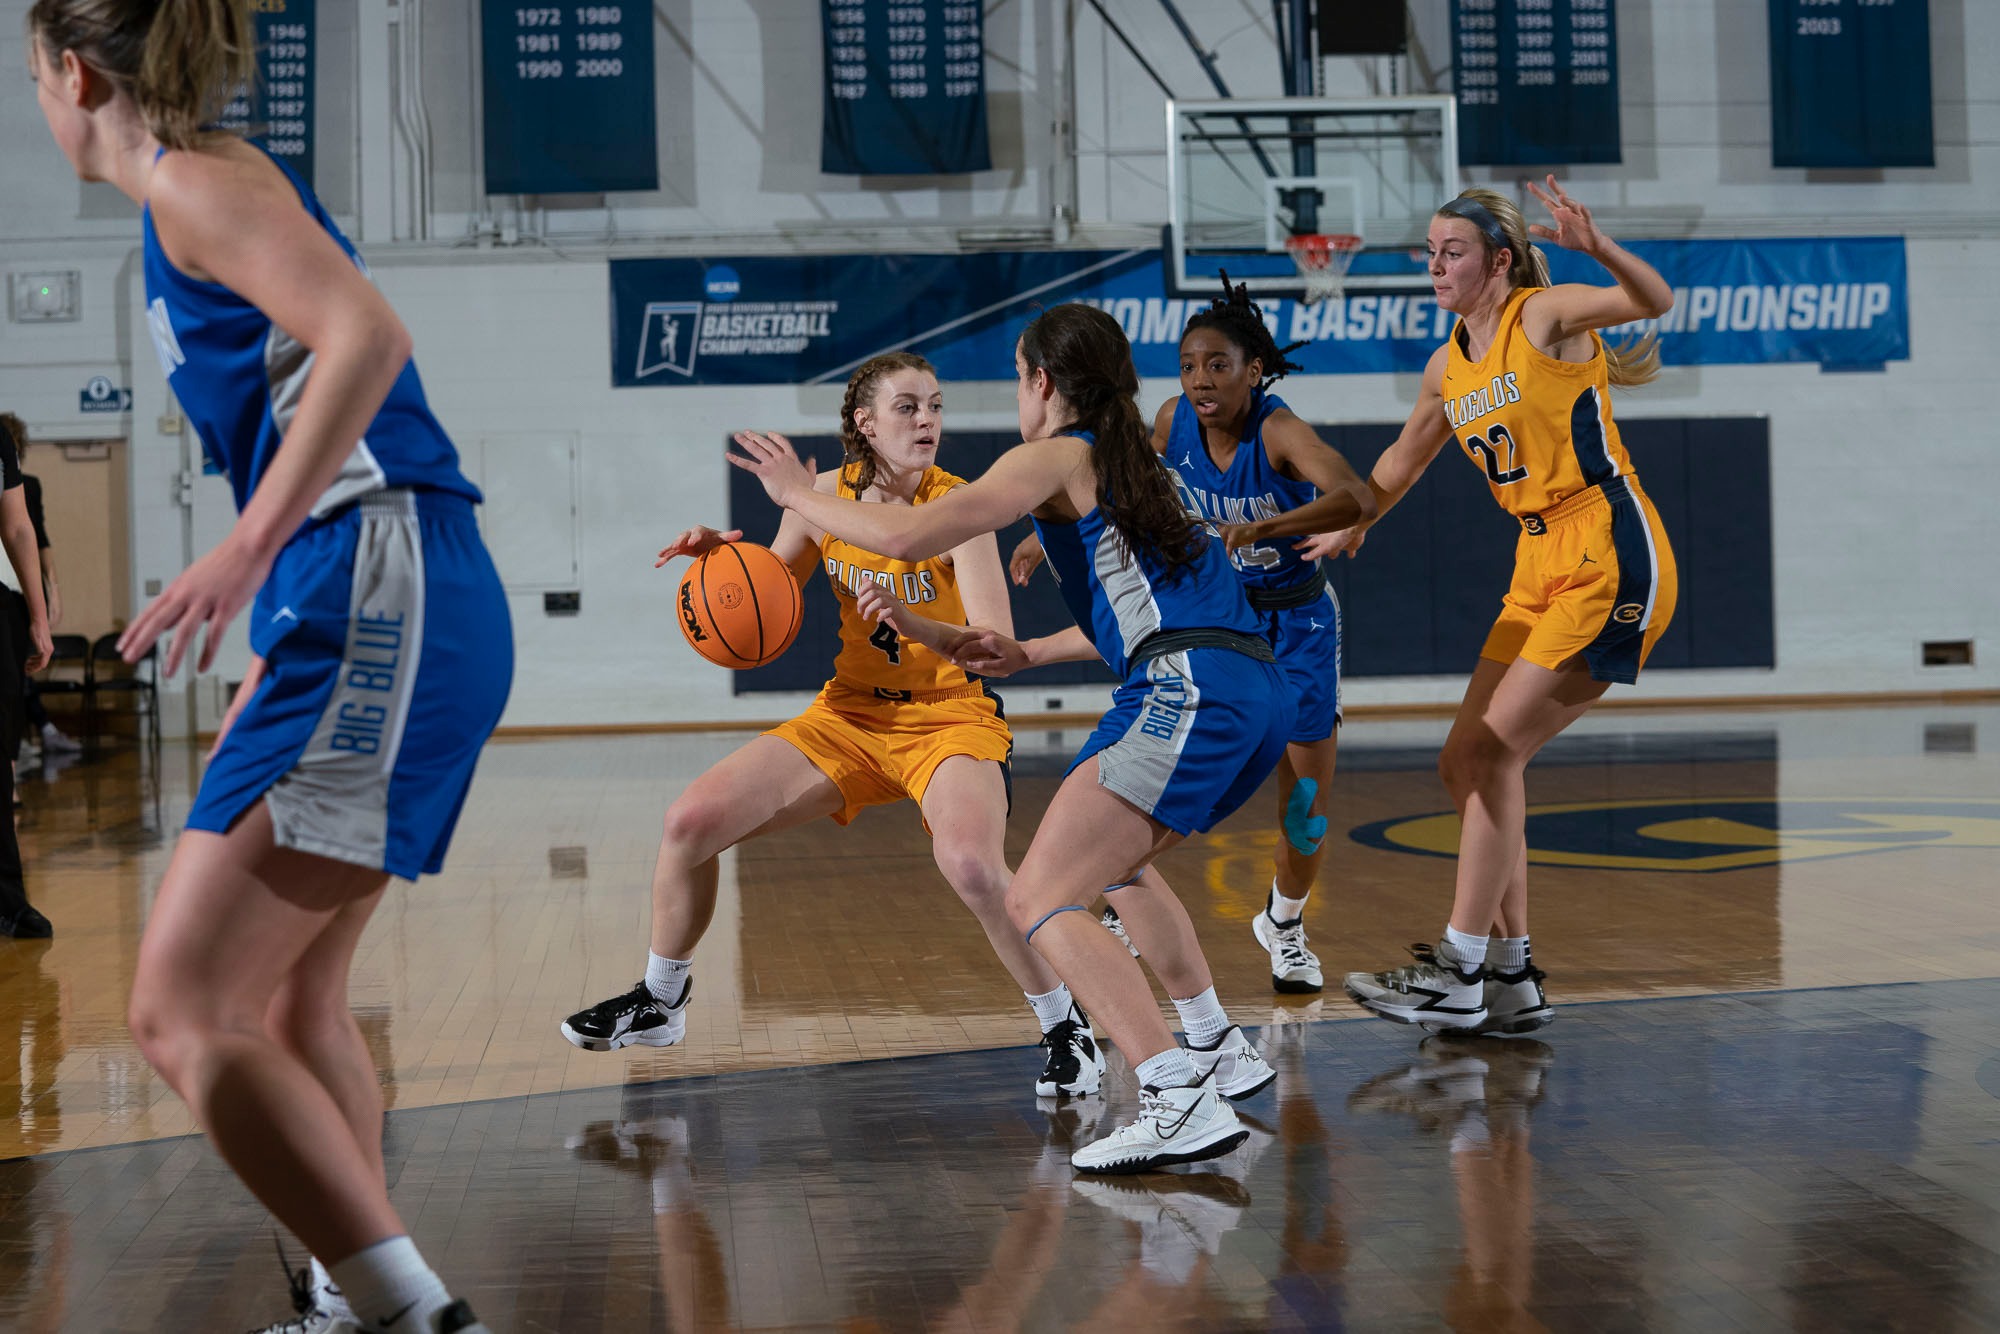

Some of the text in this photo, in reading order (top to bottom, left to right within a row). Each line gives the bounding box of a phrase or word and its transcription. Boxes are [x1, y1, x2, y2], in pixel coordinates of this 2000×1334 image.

[515, 7, 621, 26] 1972 1980
[888, 8, 926, 22] 1970
[1516, 14, 1553, 28] 1994
[1570, 13, 1607, 28] 1995
[1797, 17, 1841, 34] 2003
[888, 26, 926, 41] 1973
[1516, 33, 1553, 47] 1997
[1571, 32, 1608, 47] 1998
[516, 32, 622, 52] 1981 1989
[269, 43, 306, 58] 1970
[888, 45, 926, 60] 1977
[1570, 51, 1607, 66] 2001
[268, 63, 305, 77] 1974
[517, 59, 623, 78] 1990 2000
[889, 64, 926, 79] 1981
[268, 82, 304, 97] 1981
[268, 101, 305, 116] 1987
[268, 120, 305, 135] 1990
[267, 140, 305, 155] 2000
[1290, 296, 1450, 341] BASKET
[1598, 283, 1890, 334] MPIONSHIP
[701, 314, 830, 337] BASKETBALL
[699, 338, 809, 355] CHAMPIONSHIP
[1466, 422, 1530, 486] 22
[681, 580, 708, 642] NCAA
[868, 619, 901, 665] 4
[330, 608, 405, 755] BIG BLUE
[1140, 705, 1182, 741] BIG
